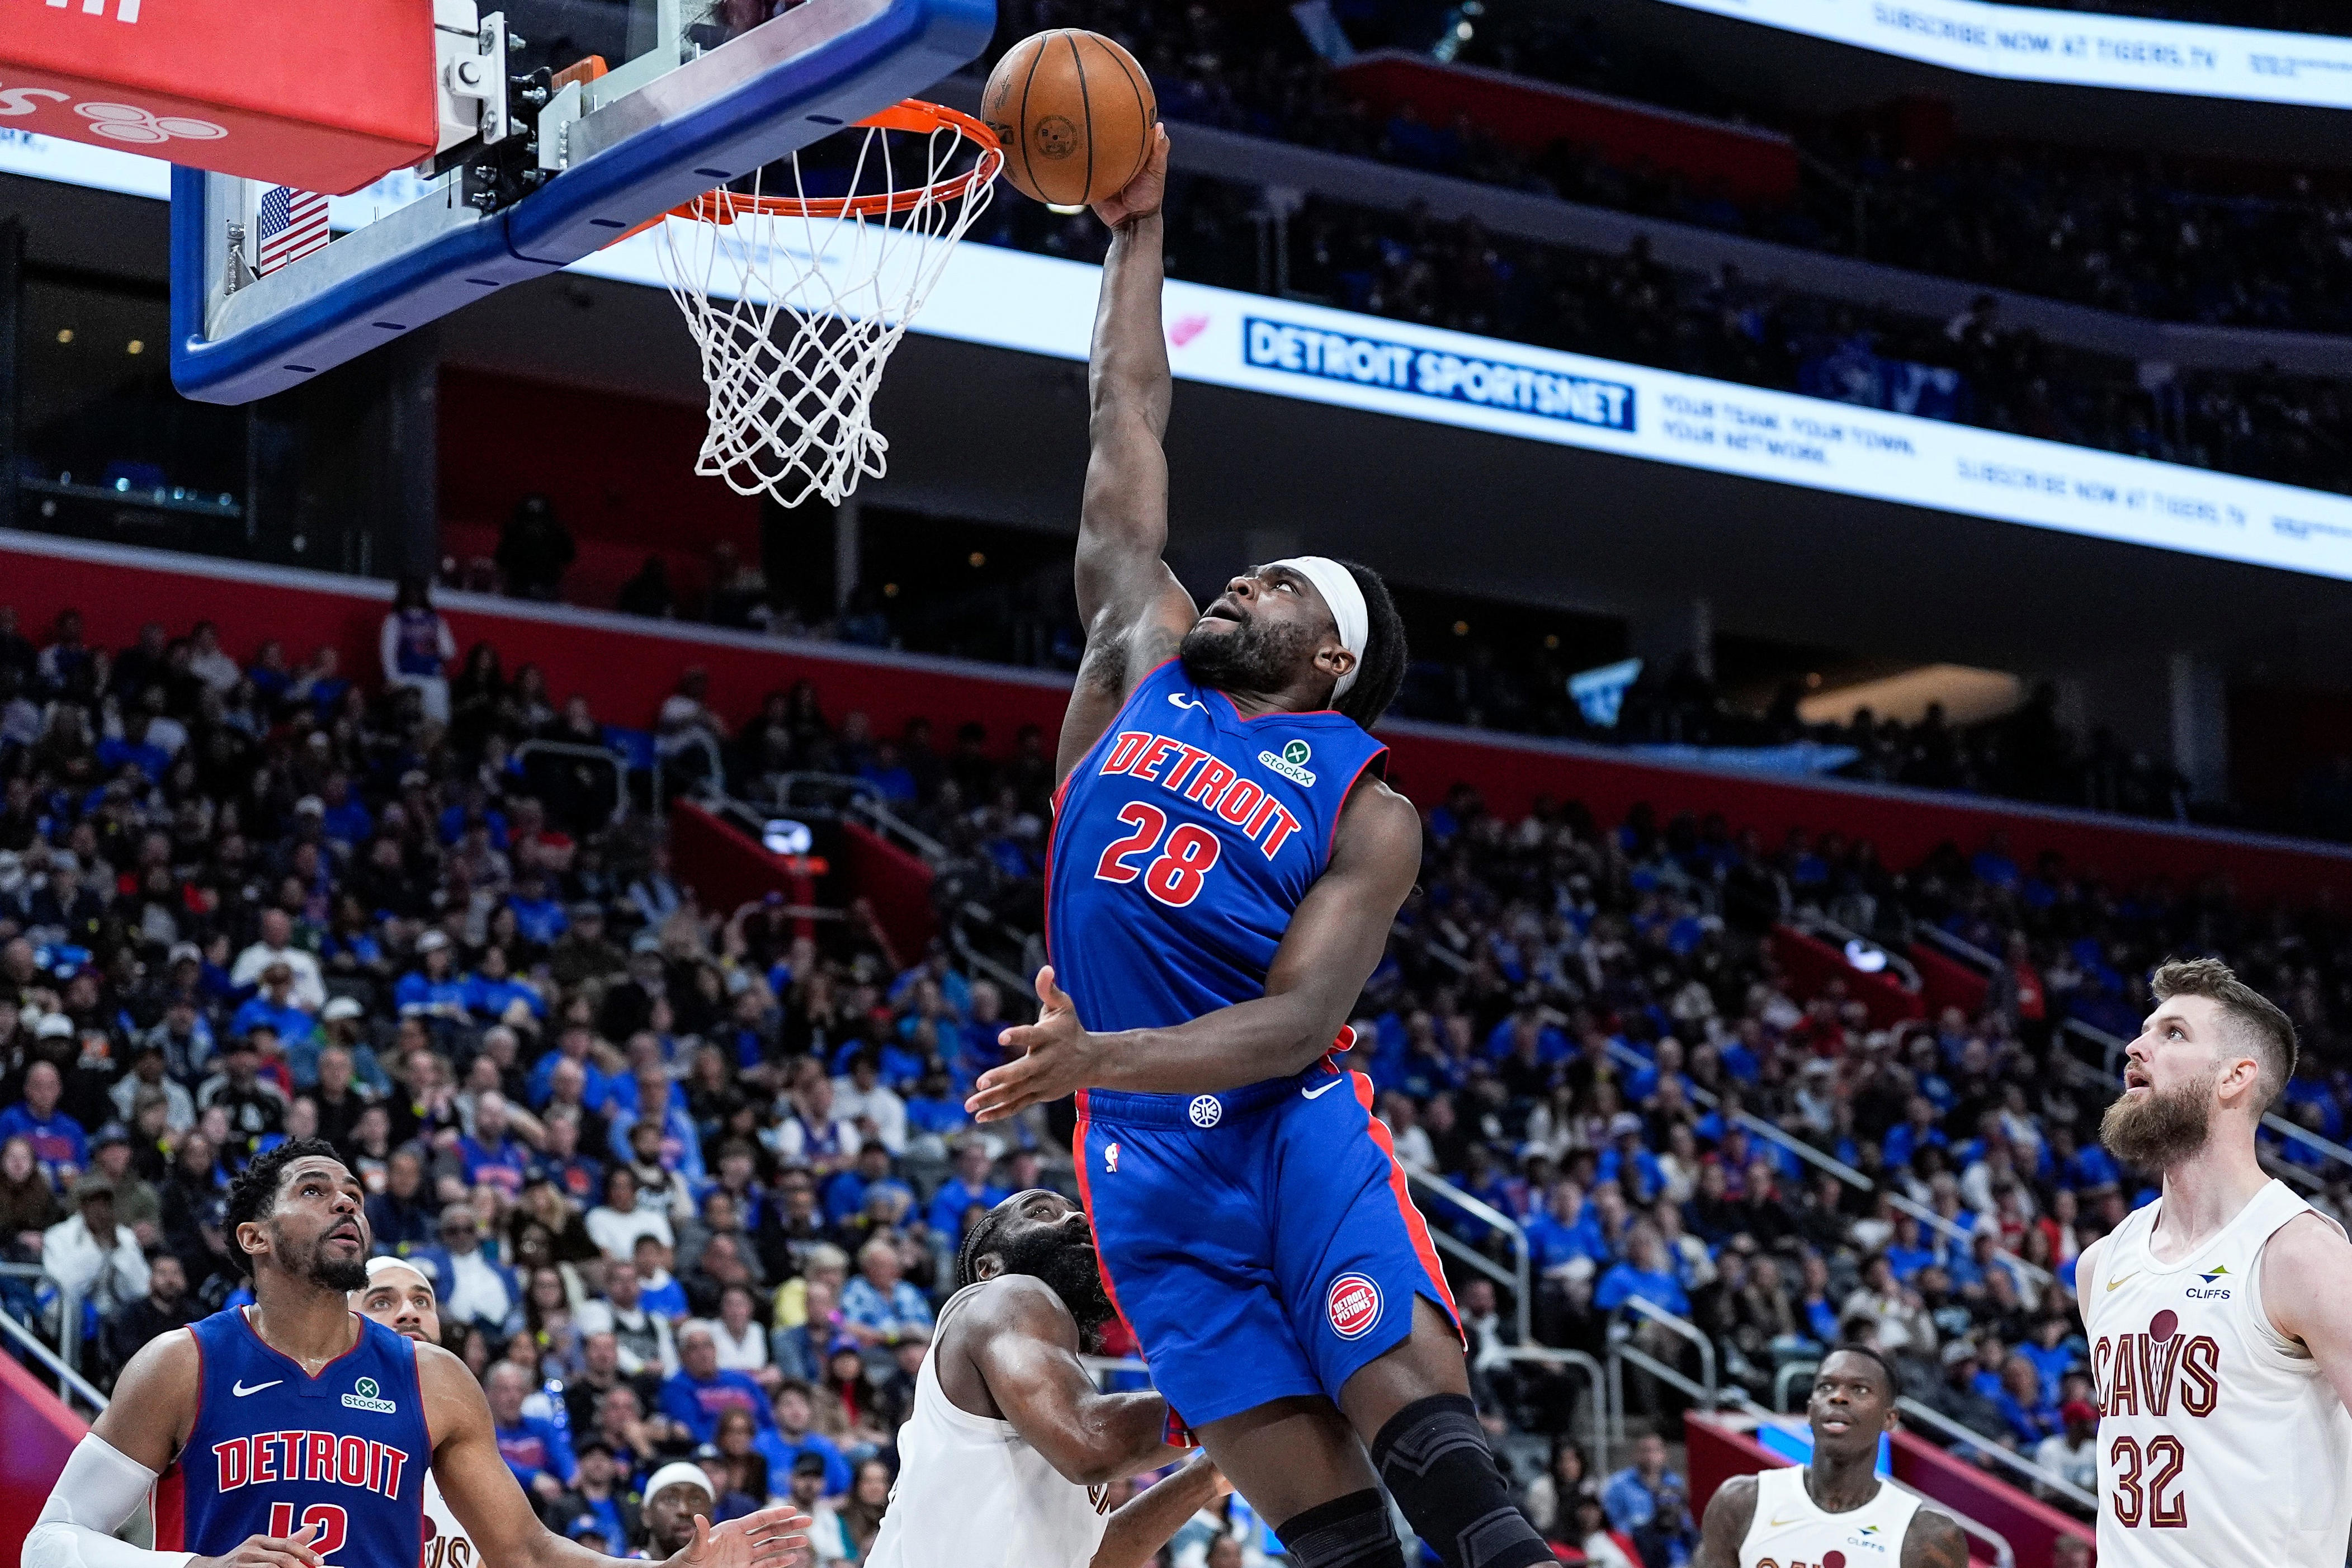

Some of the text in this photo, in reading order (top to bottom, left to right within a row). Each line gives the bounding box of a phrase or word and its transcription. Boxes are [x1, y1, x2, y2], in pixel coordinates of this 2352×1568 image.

[1250, 321, 1628, 428] DETROIT SPORTSNET
[1099, 731, 1301, 862] DETROIT
[1094, 801, 1221, 908] 28
[1333, 1287, 1367, 1314] DETROIT
[1336, 1296, 1371, 1324] PISTONS
[2186, 1288, 2231, 1300] CLIFFS
[344, 1396, 393, 1411] StockX
[2094, 1333, 2220, 1418] CAVS
[212, 1430, 408, 1500] DETROIT
[2110, 1434, 2188, 1528] 32
